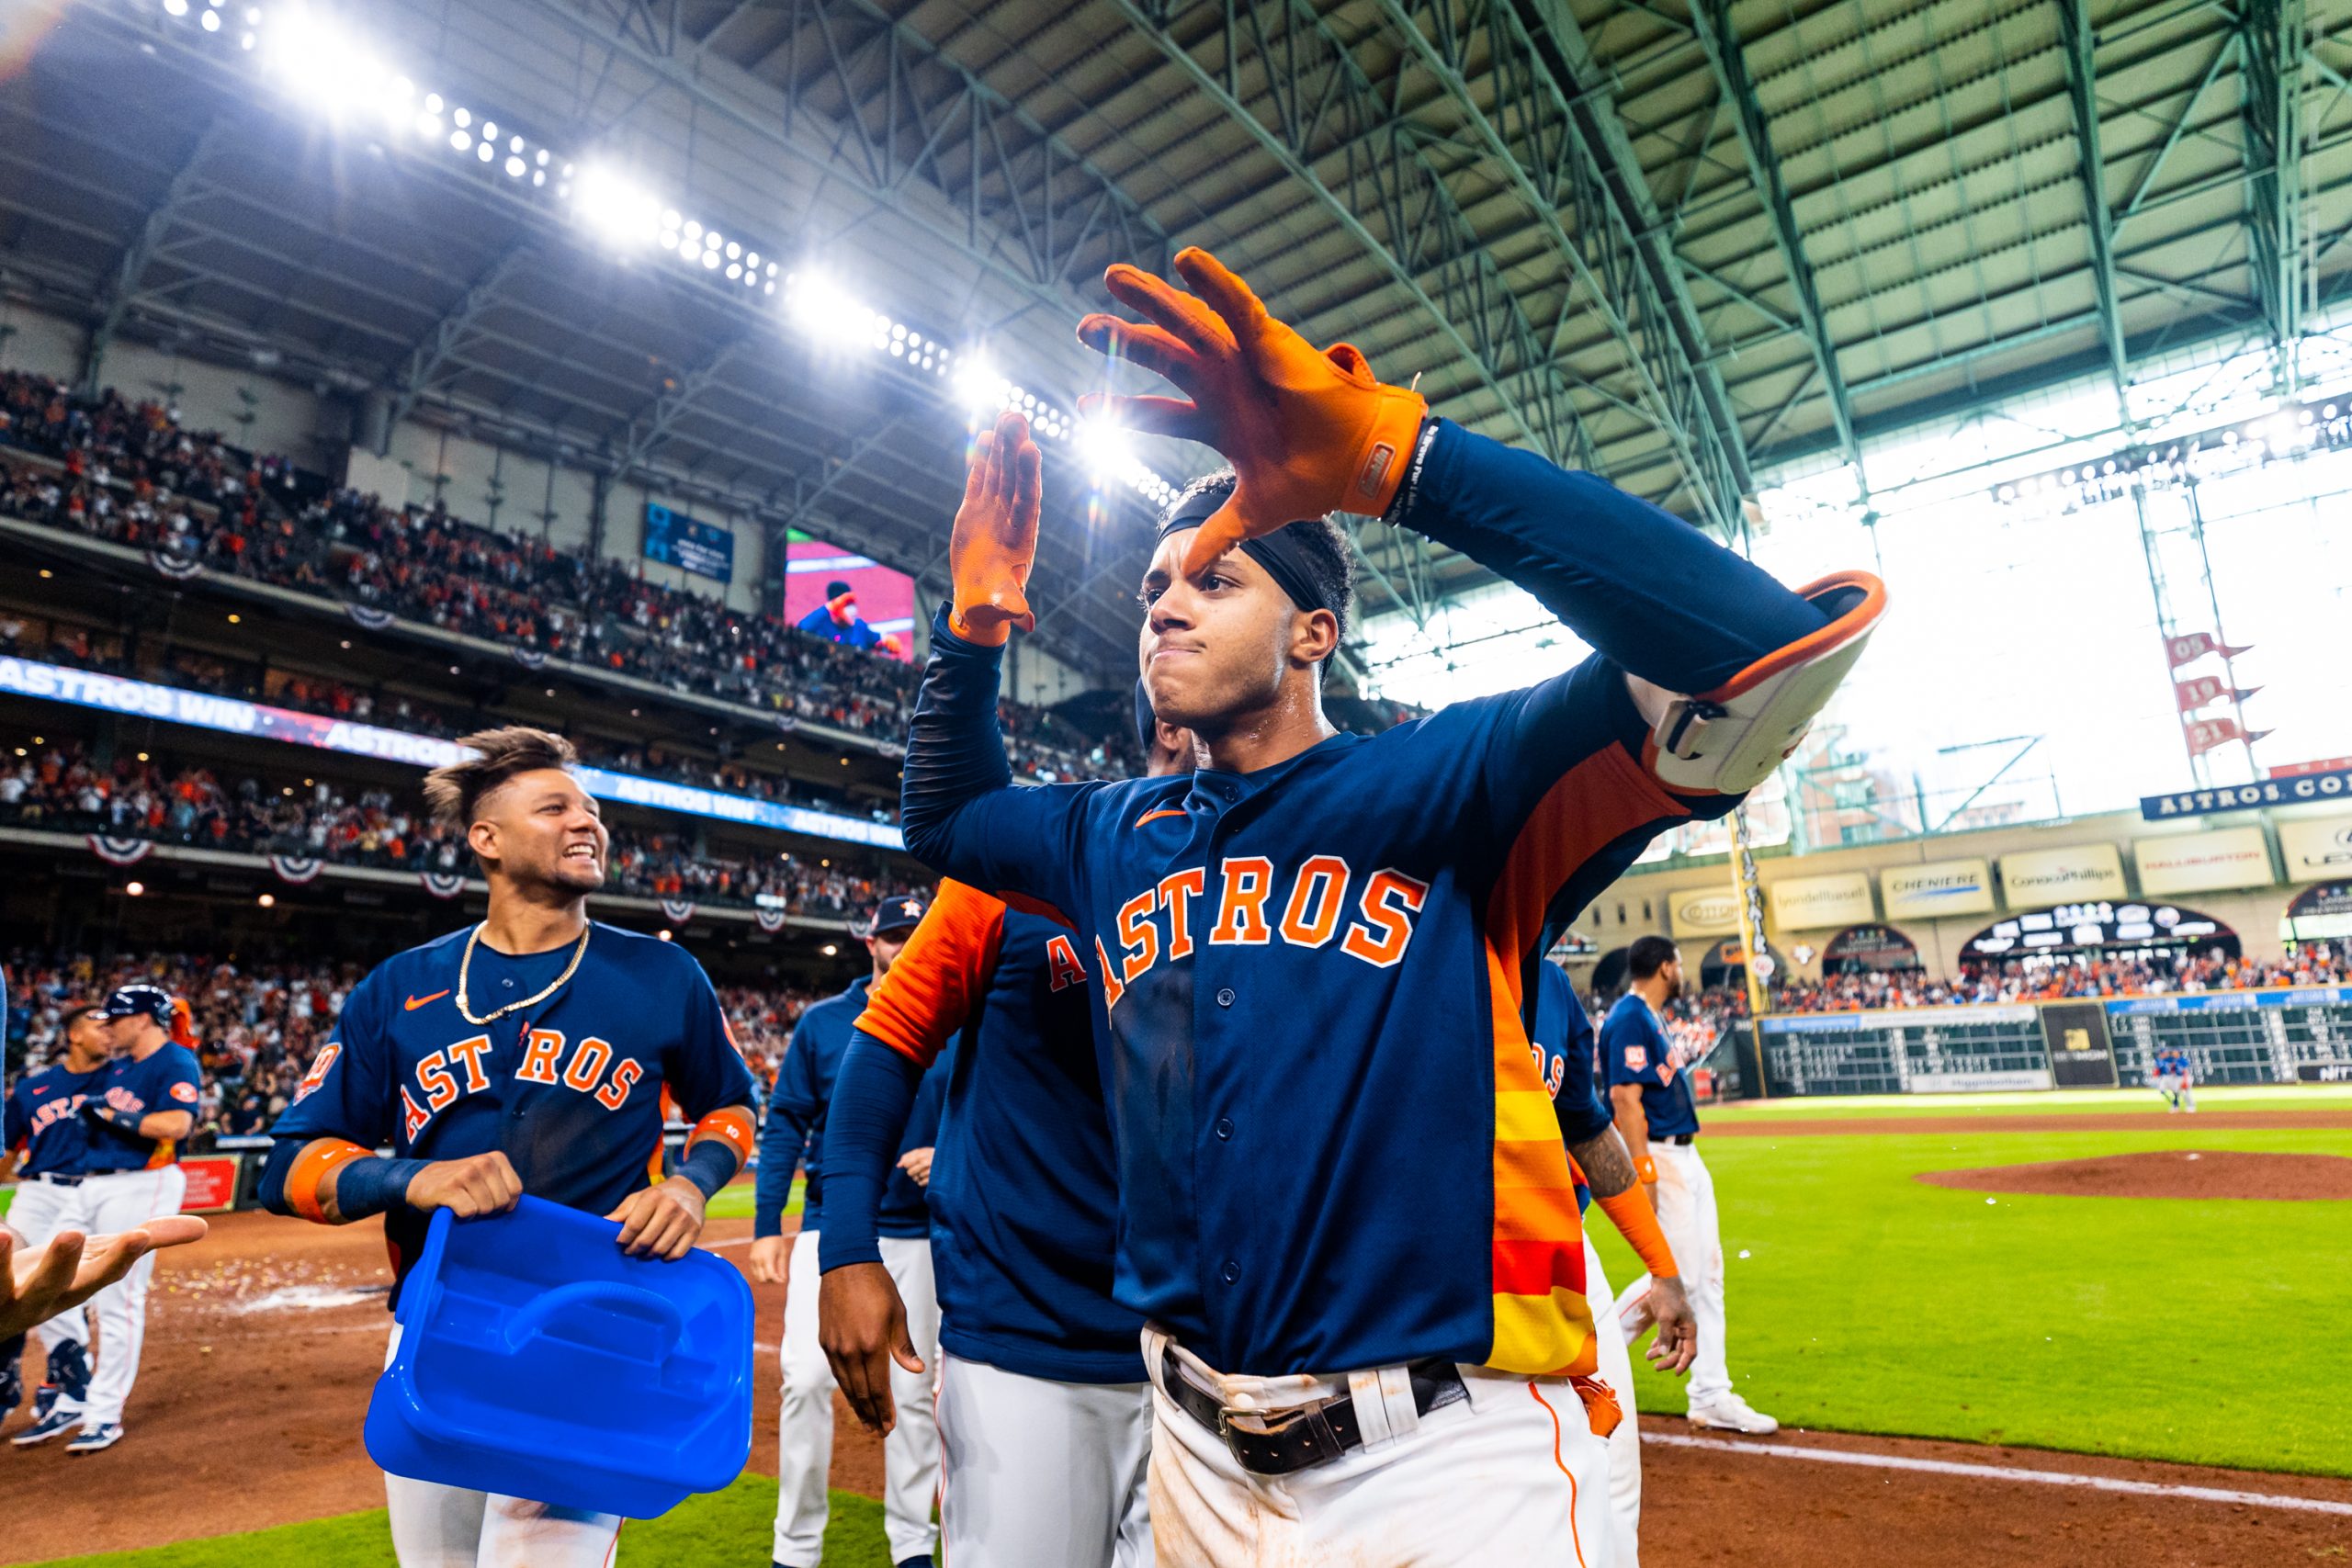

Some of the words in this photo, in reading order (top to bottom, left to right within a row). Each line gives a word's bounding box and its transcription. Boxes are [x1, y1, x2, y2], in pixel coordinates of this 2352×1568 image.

[0, 657, 173, 716] ASTROS
[178, 692, 256, 731] WIN
[2188, 680, 2216, 703] 19
[323, 723, 458, 766] ASTROS
[2194, 722, 2222, 744] 21
[616, 775, 709, 810] ASTROS
[712, 794, 756, 822] WIN
[2159, 784, 2280, 815] ASTROS
[793, 812, 866, 840] ASTROS
[2144, 851, 2260, 871] HALLIBURTON
[1891, 874, 1979, 892] CHENIERE
[2010, 866, 2116, 888] ConocoPhillips
[1093, 854, 1430, 1012] ASTROS
[399, 1028, 645, 1145] ASTROS
[725, 1124, 740, 1139] 10
